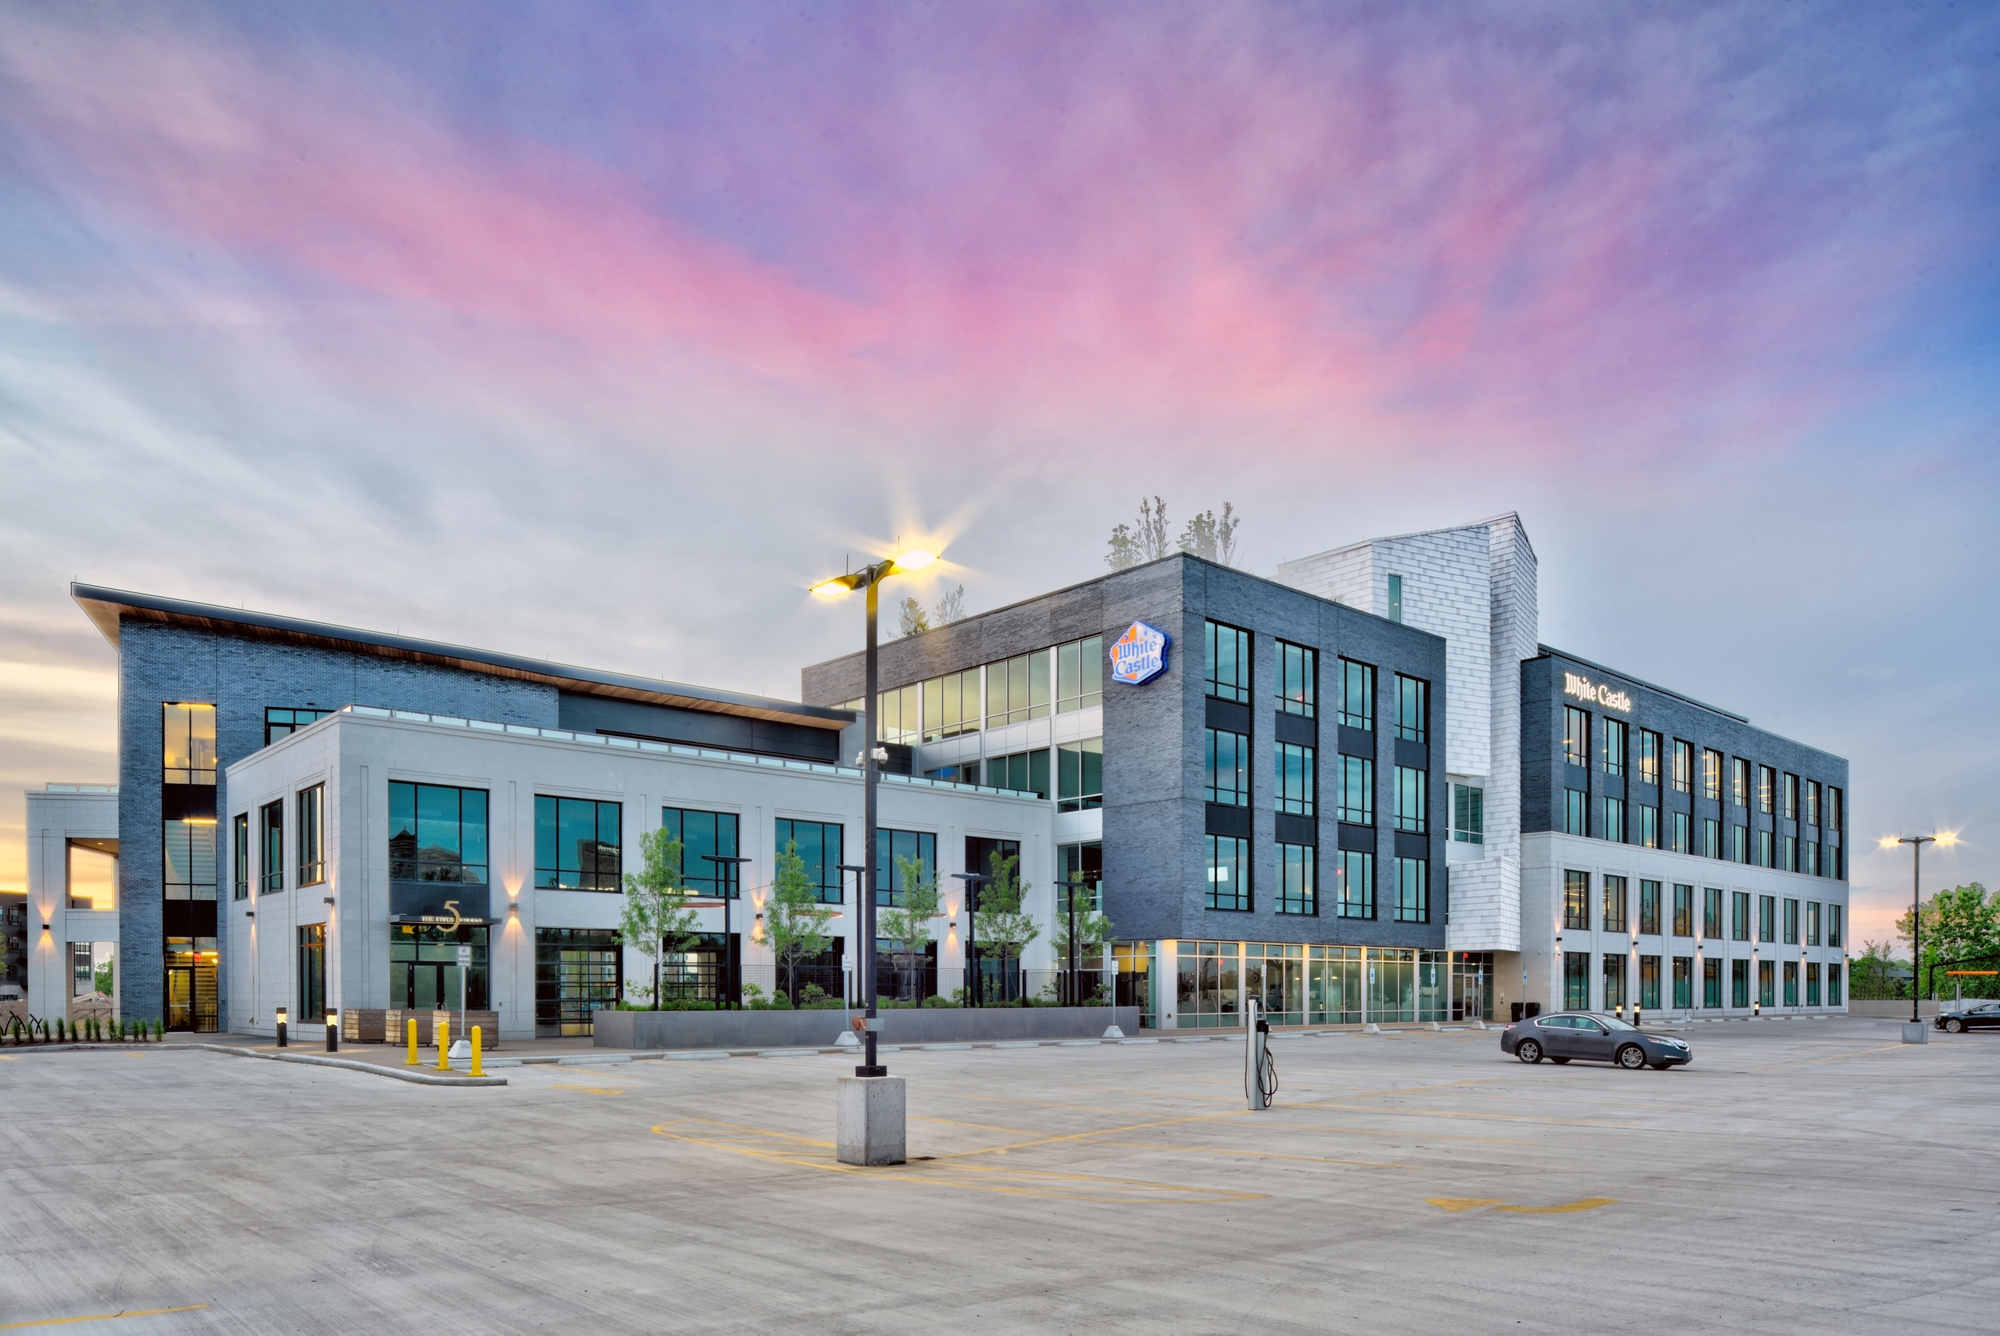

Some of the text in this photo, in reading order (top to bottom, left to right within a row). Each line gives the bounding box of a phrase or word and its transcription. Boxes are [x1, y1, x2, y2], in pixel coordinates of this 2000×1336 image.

[1118, 638, 1157, 660] White
[1115, 655, 1159, 677] Castle
[1564, 672, 1631, 713] White Castle
[436, 900, 461, 932] 5
